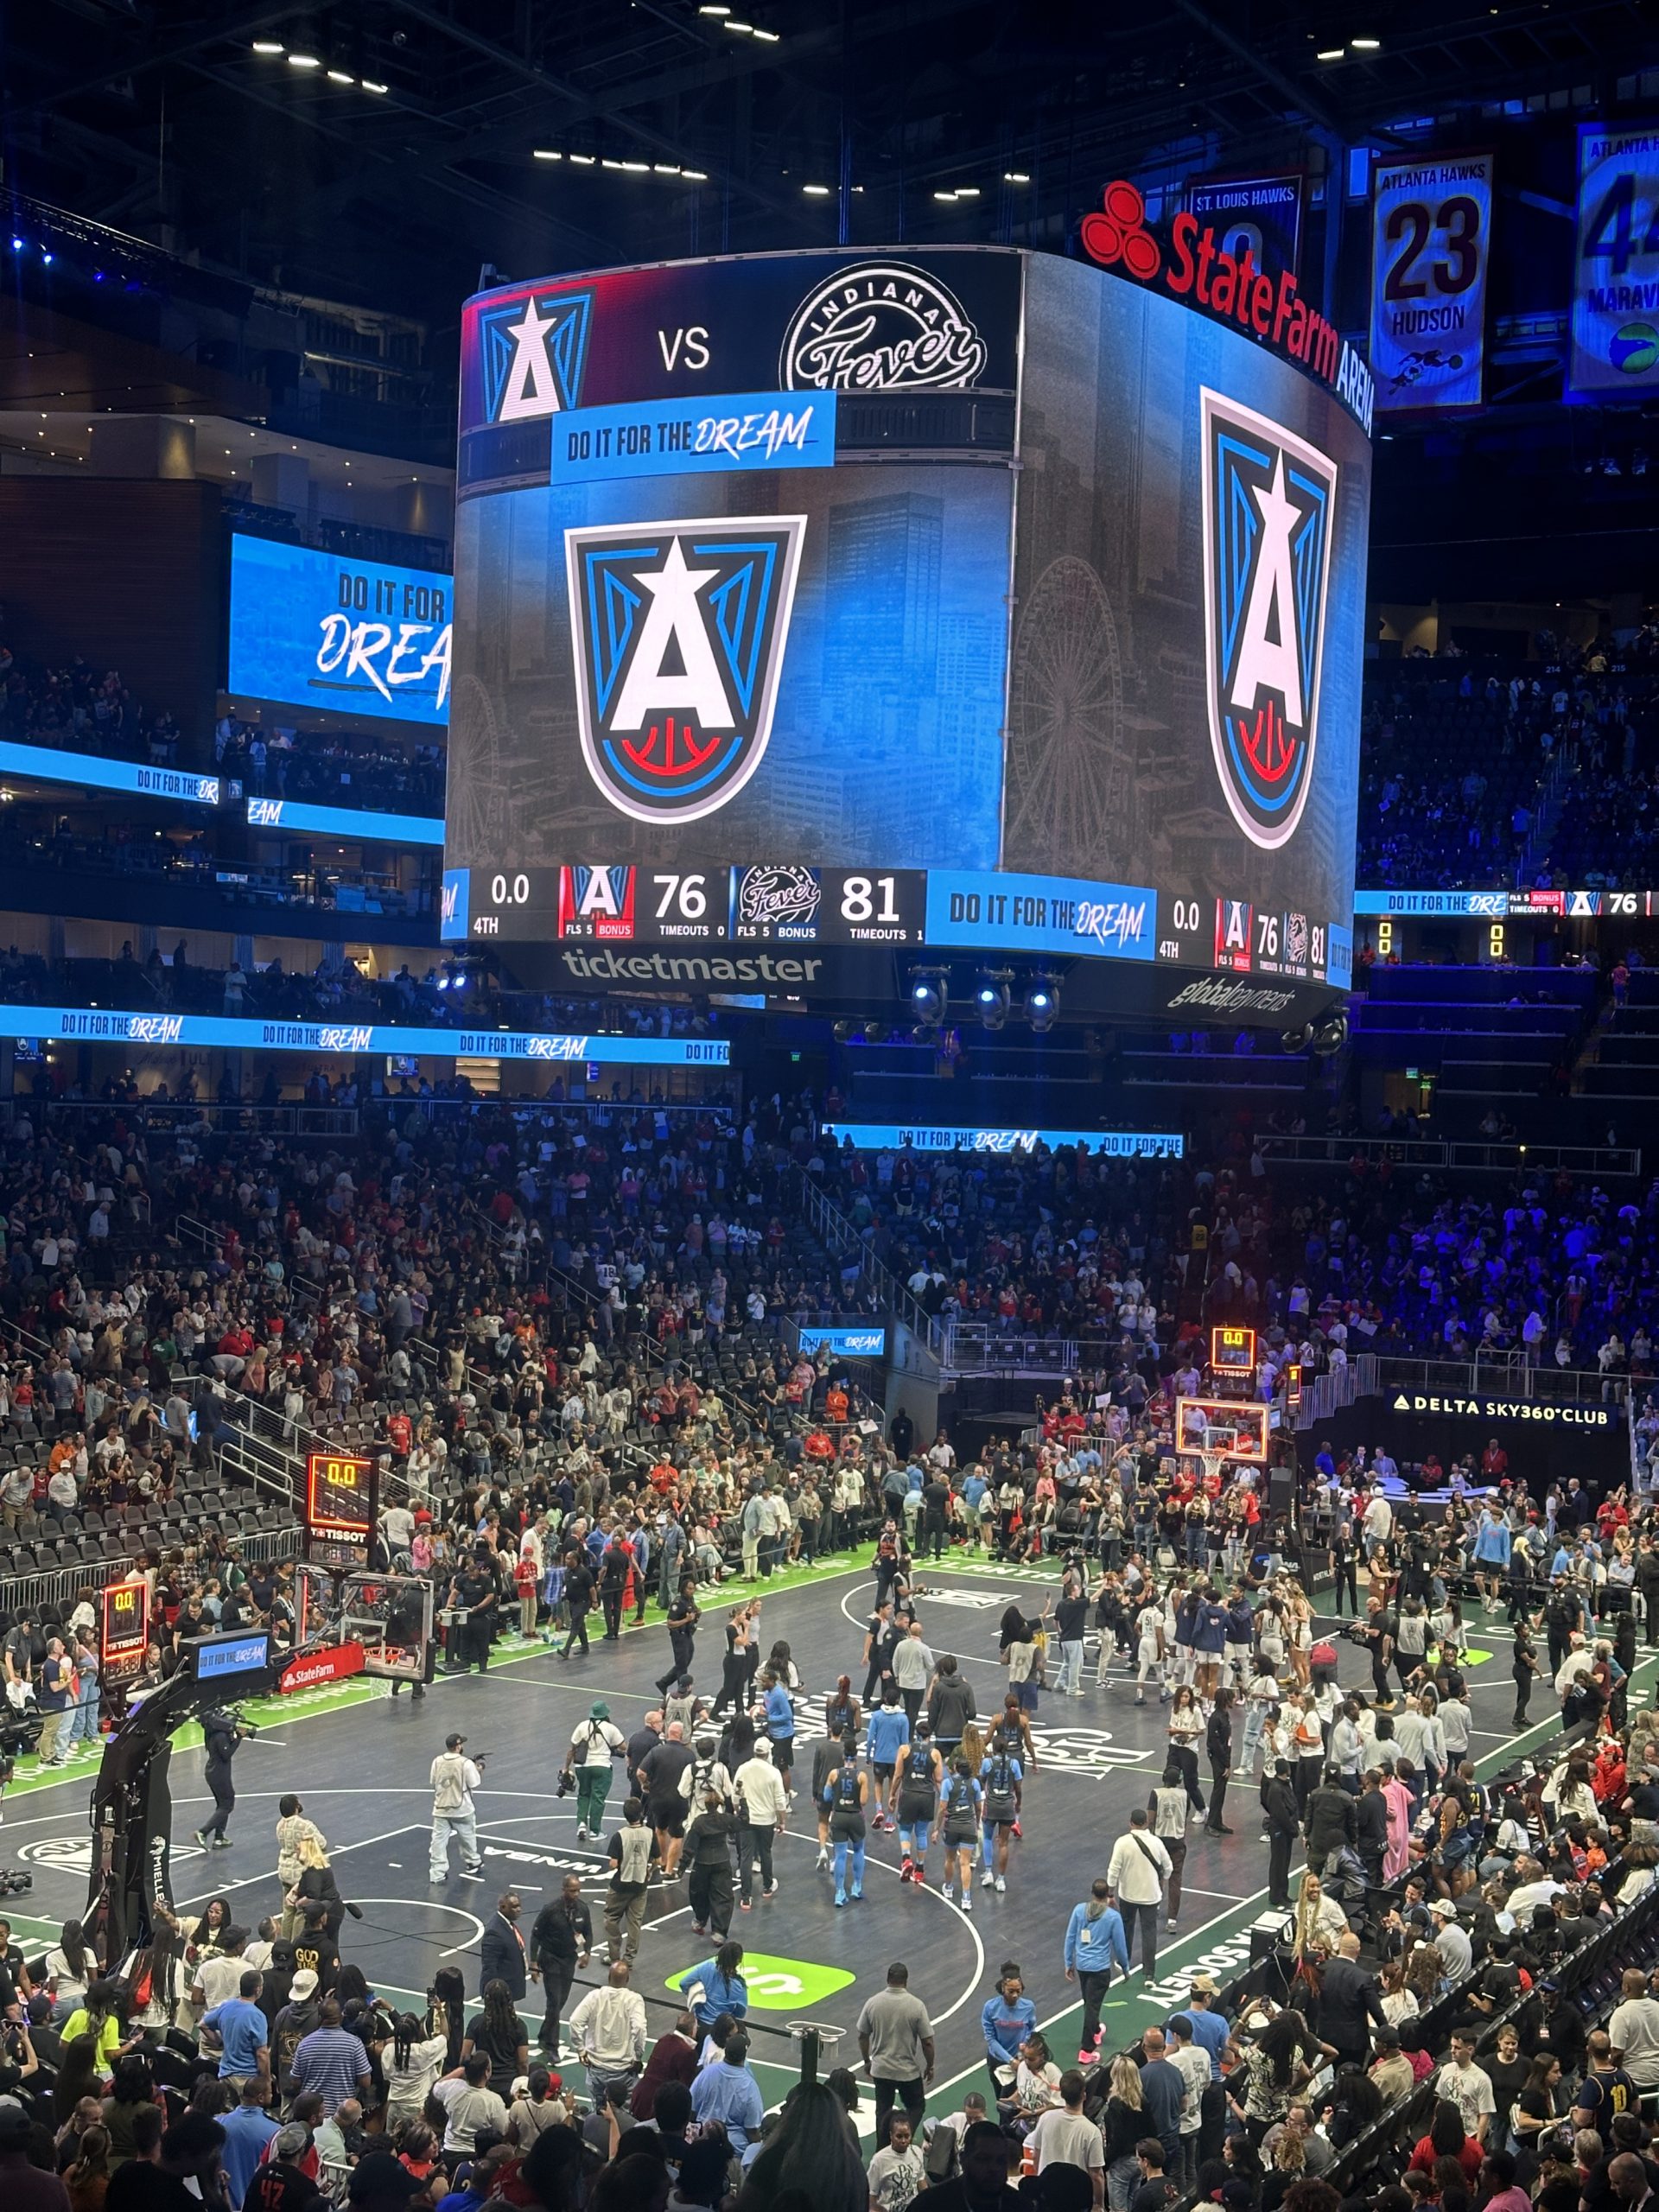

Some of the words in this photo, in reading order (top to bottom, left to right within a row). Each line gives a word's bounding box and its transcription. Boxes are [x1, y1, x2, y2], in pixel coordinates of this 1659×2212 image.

[1590, 137, 1649, 158] ATLANTA
[1382, 169, 1437, 191] ATLANTA
[1440, 163, 1485, 183] HAWKS
[1197, 196, 1212, 212] ST.
[1216, 192, 1249, 210] LOUIS
[1252, 187, 1295, 206] HAWKS
[1384, 196, 1481, 301] 23
[810, 281, 939, 333] INDIANA
[1392, 306, 1465, 335] HUDSON
[658, 327, 710, 372] VS
[795, 315, 982, 388] Fever
[1336, 340, 1375, 438] ARENA
[568, 431, 590, 461] DO
[595, 428, 613, 457] IT
[617, 424, 652, 455] FOR
[657, 420, 691, 452] THE
[694, 406, 813, 460] DREAM
[339, 573, 368, 611] DO
[376, 579, 396, 615] IT
[404, 584, 444, 624] FOR
[137, 770, 150, 787] DO
[152, 772, 161, 789] IT
[162, 775, 179, 792] FOR
[181, 778, 198, 796] THE
[492, 874, 530, 905] 0.0
[653, 874, 707, 918] 76
[743, 877, 821, 916] Fever
[840, 876, 899, 922] 81
[1533, 894, 1560, 903] BONUS
[1173, 899, 1199, 931] 0.0
[1389, 895, 1404, 912] DO
[1408, 895, 1419, 912] IT
[1421, 895, 1443, 912] FOR
[1447, 895, 1467, 912] THE
[1510, 905, 1548, 913] TIMEOUTS
[1609, 893, 1637, 913] 76
[474, 917, 499, 934] 4TH
[566, 924, 582, 935] FLS
[587, 925, 593, 935] 5
[599, 925, 631, 936] BONUS
[659, 925, 709, 936] TIMEOUTS
[717, 926, 724, 936] 0
[737, 926, 756, 938] FLS
[763, 927, 770, 938] 5
[778, 927, 817, 938] BONUS
[950, 893, 981, 923] DO
[988, 894, 1007, 925] IT
[1013, 896, 1046, 927] FOR
[1052, 899, 1075, 931] THE
[1076, 901, 1146, 949] DREAM
[850, 928, 906, 941] TIMEOUTS
[917, 931, 923, 941] 1
[1258, 914, 1278, 956] 76
[1312, 926, 1325, 965] 81
[1159, 941, 1179, 958] 4TH
[562, 948, 822, 982] ticketmaster
[62, 1014, 75, 1033] DO
[78, 1015, 88, 1033] IT
[90, 1016, 108, 1034] FOR
[111, 1018, 129, 1035] THE
[130, 1015, 183, 1042] DREAM
[264, 1026, 275, 1043] DO
[276, 1027, 285, 1044] IT
[287, 1027, 302, 1045] FOR
[305, 1028, 320, 1046] THE
[320, 1027, 372, 1052] DREAM
[461, 1035, 474, 1052] DO
[476, 1035, 486, 1052] IT
[488, 1036, 507, 1053] FOR
[511, 1037, 527, 1053] THE
[528, 1036, 588, 1060] DREAM
[686, 1044, 701, 1059] DO
[704, 1045, 715, 1060] IT
[917, 1131, 927, 1146] IT
[931, 1131, 950, 1146] FOR
[954, 1132, 974, 1147] THE
[975, 1130, 1038, 1154] DREAM
[1104, 1137, 1118, 1152] DO
[1122, 1137, 1133, 1153] IT
[1136, 1138, 1156, 1153] FOR
[1160, 1139, 1180, 1154] THE
[835, 1338, 846, 1346] THE
[845, 1335, 881, 1351] DREAM
[1223, 1332, 1243, 1344] 0.0
[1414, 1396, 1479, 1415] DELTA
[327, 1463, 355, 1485] 0.0
[327, 1529, 366, 1543] TISSOT
[115, 1592, 133, 1611] 0.0
[118, 1637, 144, 1650] TISSOT
[200, 1656, 207, 1668] DO
[208, 1655, 213, 1665] IT
[215, 1653, 226, 1664] FOR
[226, 1651, 235, 1662] THE
[235, 1644, 266, 1662] DREAM
[913, 1752, 927, 1767] 24
[842, 1778, 853, 1792] 15
[994, 1770, 1009, 1783] 33
[960, 1786, 968, 1798] 2
[1470, 1792, 1480, 1807] 21
[484, 1846, 602, 1874] WNBA
[153, 1855, 165, 1902] MIELLE
[296, 1948, 319, 1963] GOD
[1136, 1945, 1251, 2009] SOCIETY
[1610, 2084, 1628, 2114] 10
